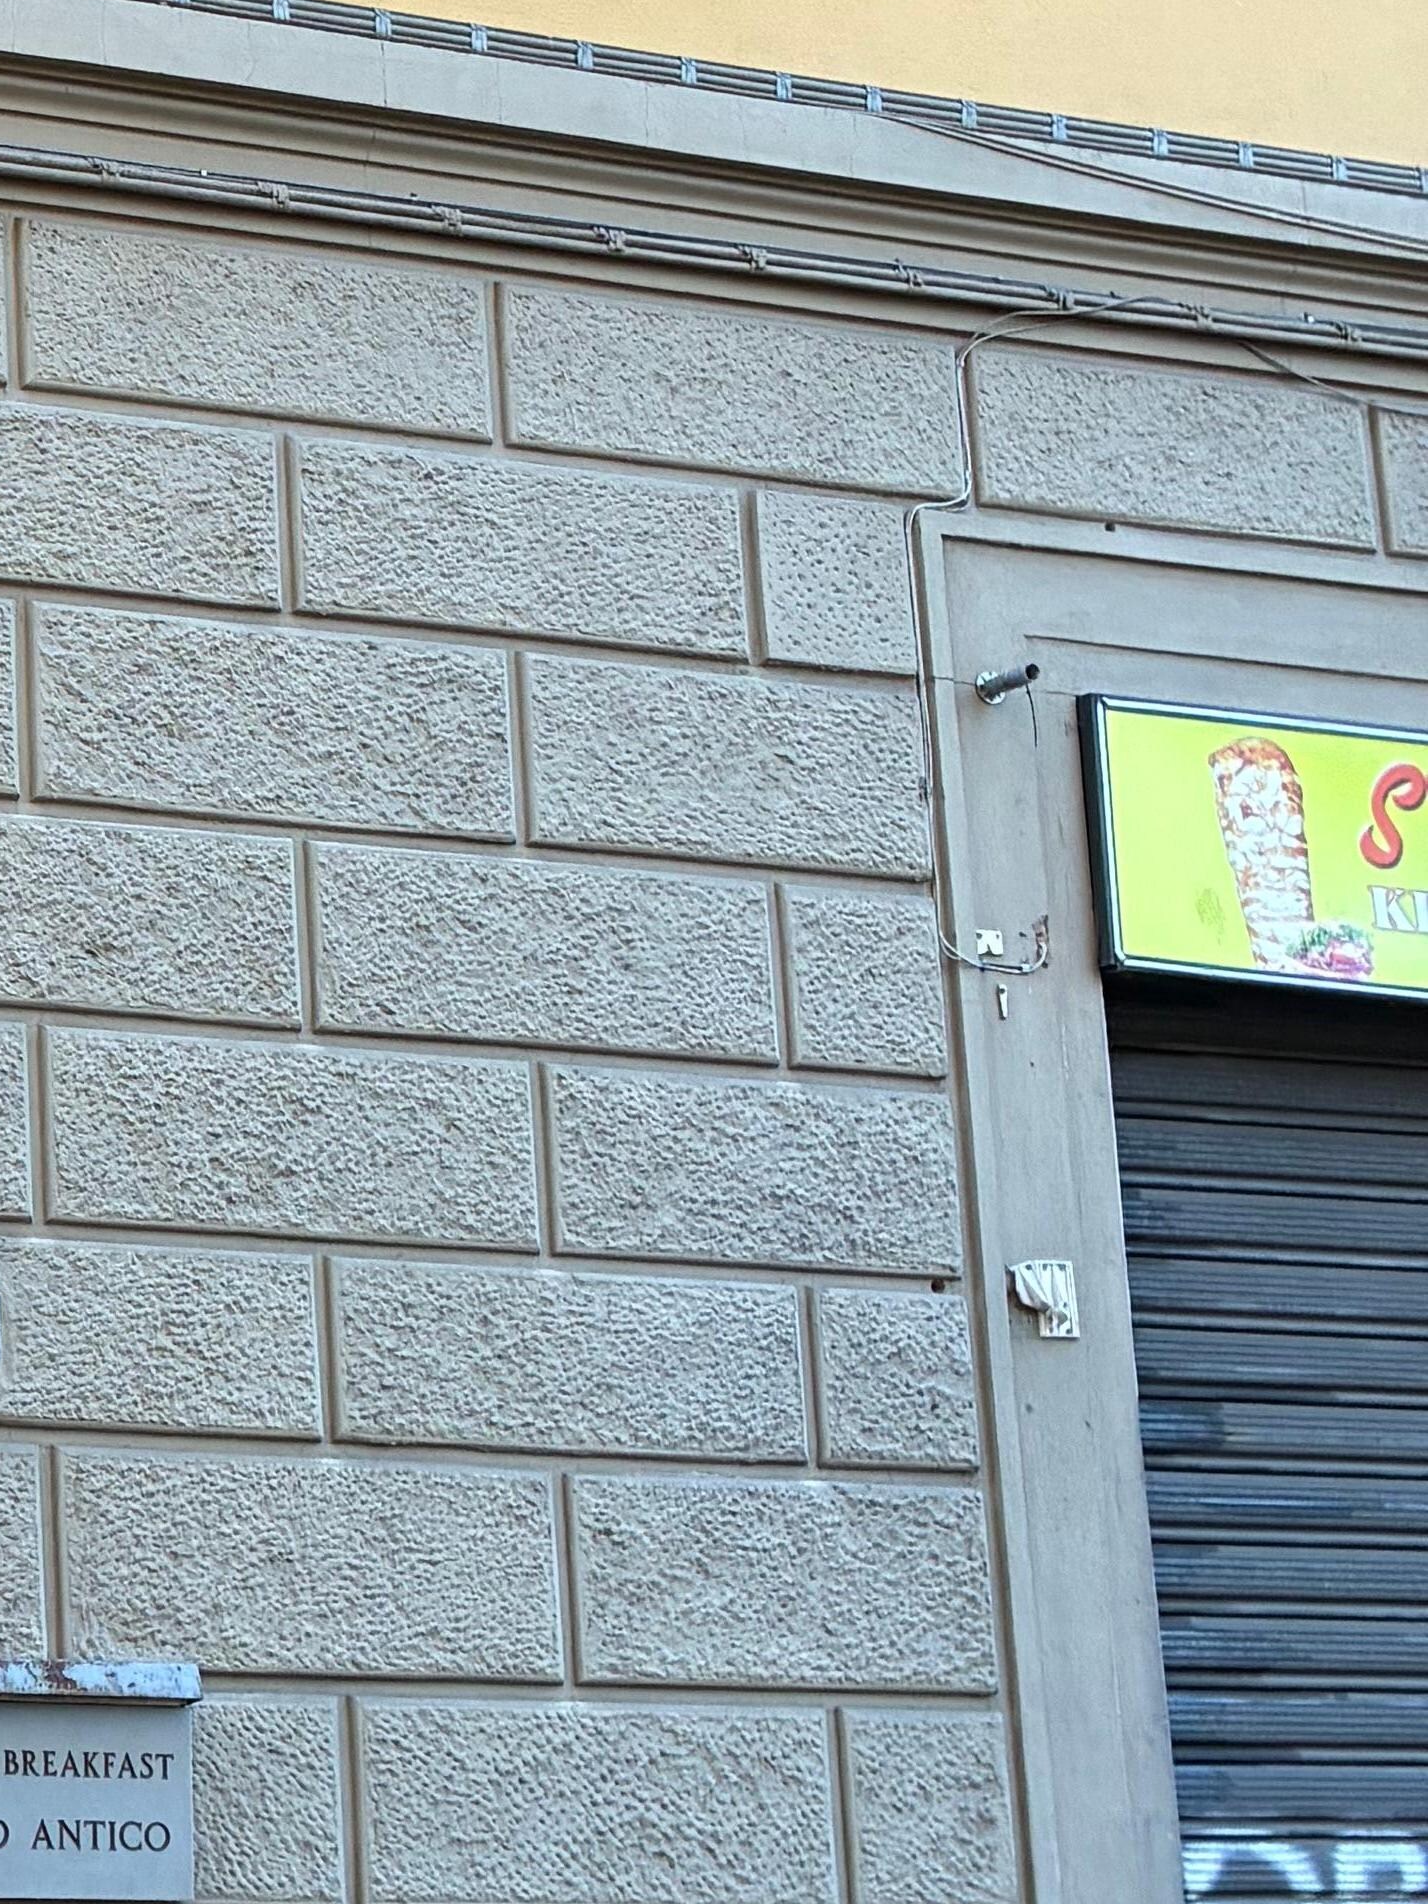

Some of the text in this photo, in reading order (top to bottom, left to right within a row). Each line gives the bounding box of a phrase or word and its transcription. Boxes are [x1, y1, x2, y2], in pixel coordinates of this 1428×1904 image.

[1358, 763, 1428, 869] S
[3, 1749, 175, 1780] BREAKFAST
[31, 1818, 172, 1853] ANTICO
